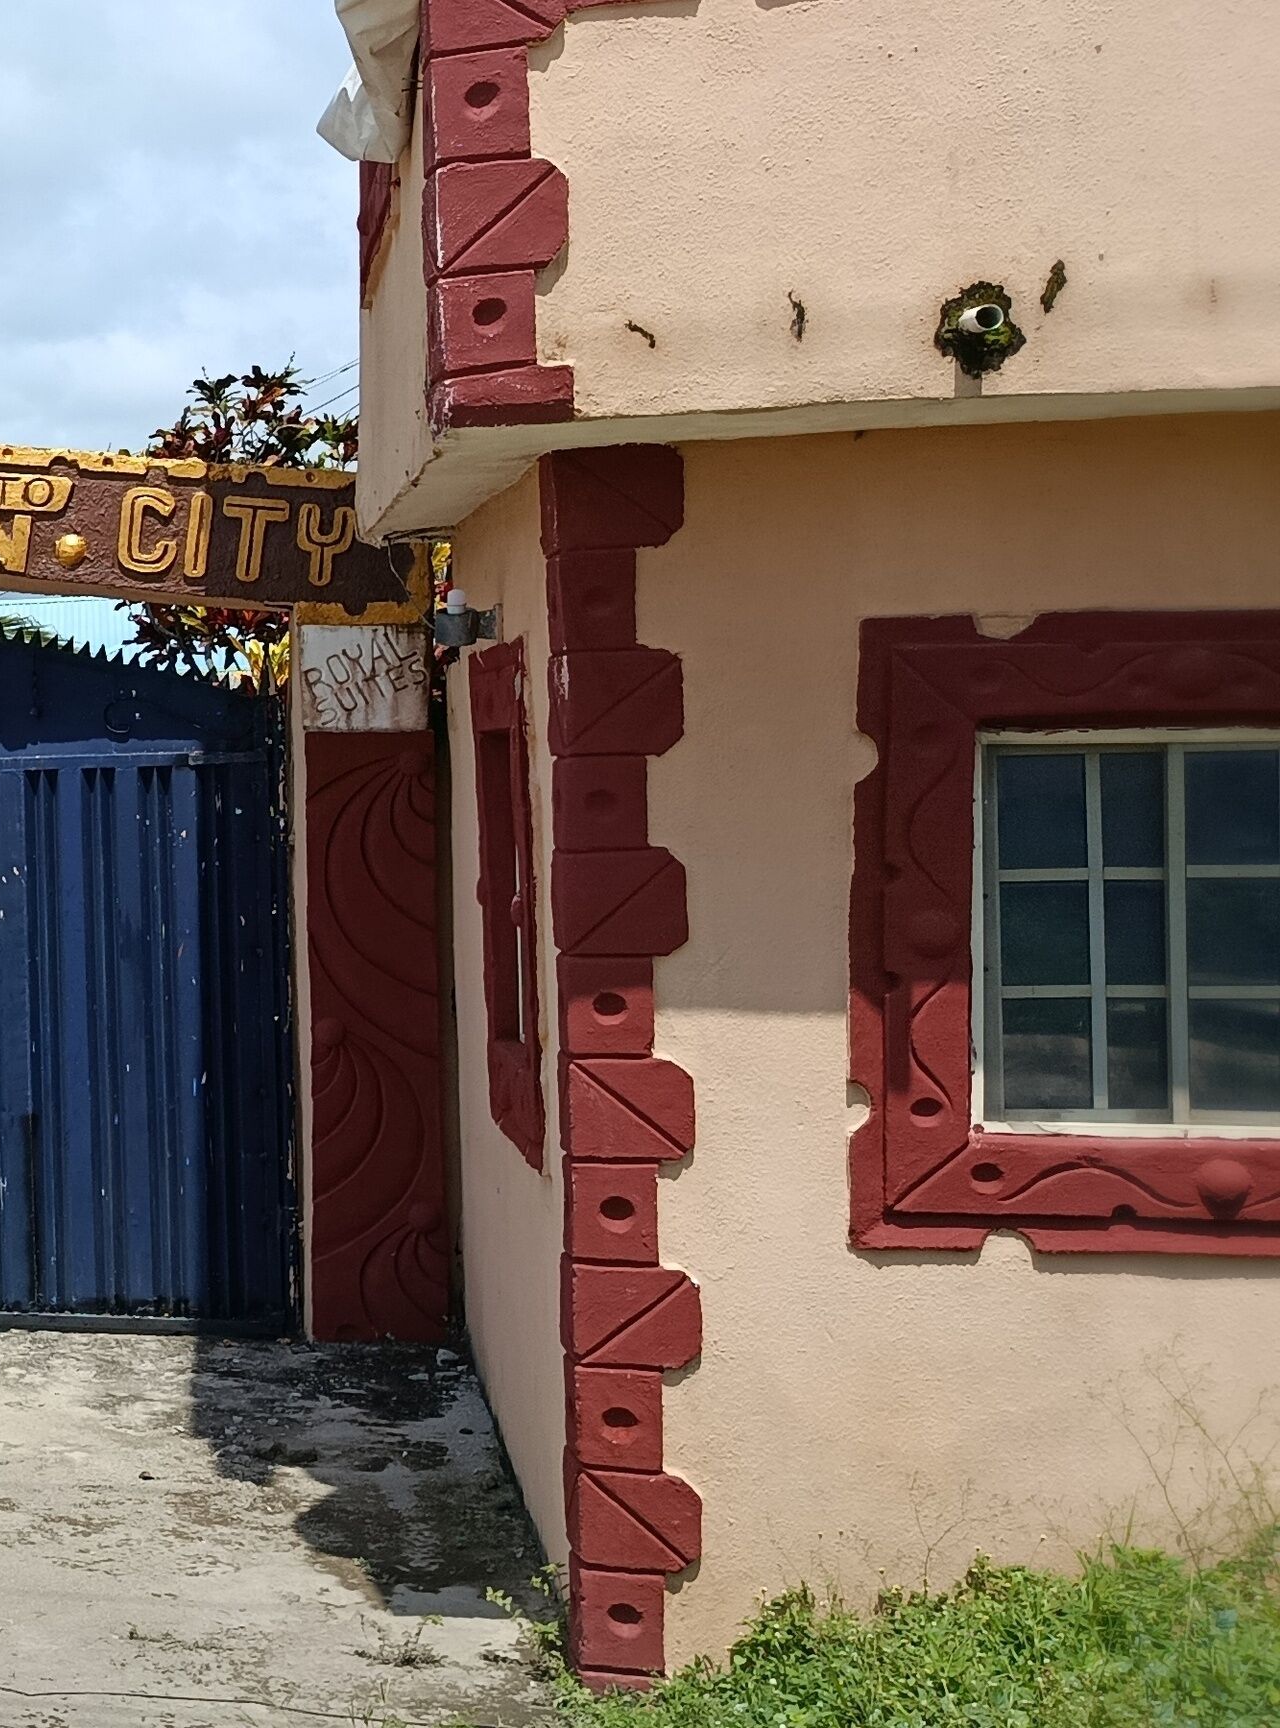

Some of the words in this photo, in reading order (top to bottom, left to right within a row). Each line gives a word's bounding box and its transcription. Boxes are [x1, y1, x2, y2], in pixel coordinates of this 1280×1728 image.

[118, 487, 355, 586] CITY
[304, 632, 417, 699] ROYAL
[316, 657, 428, 725] SUITES
